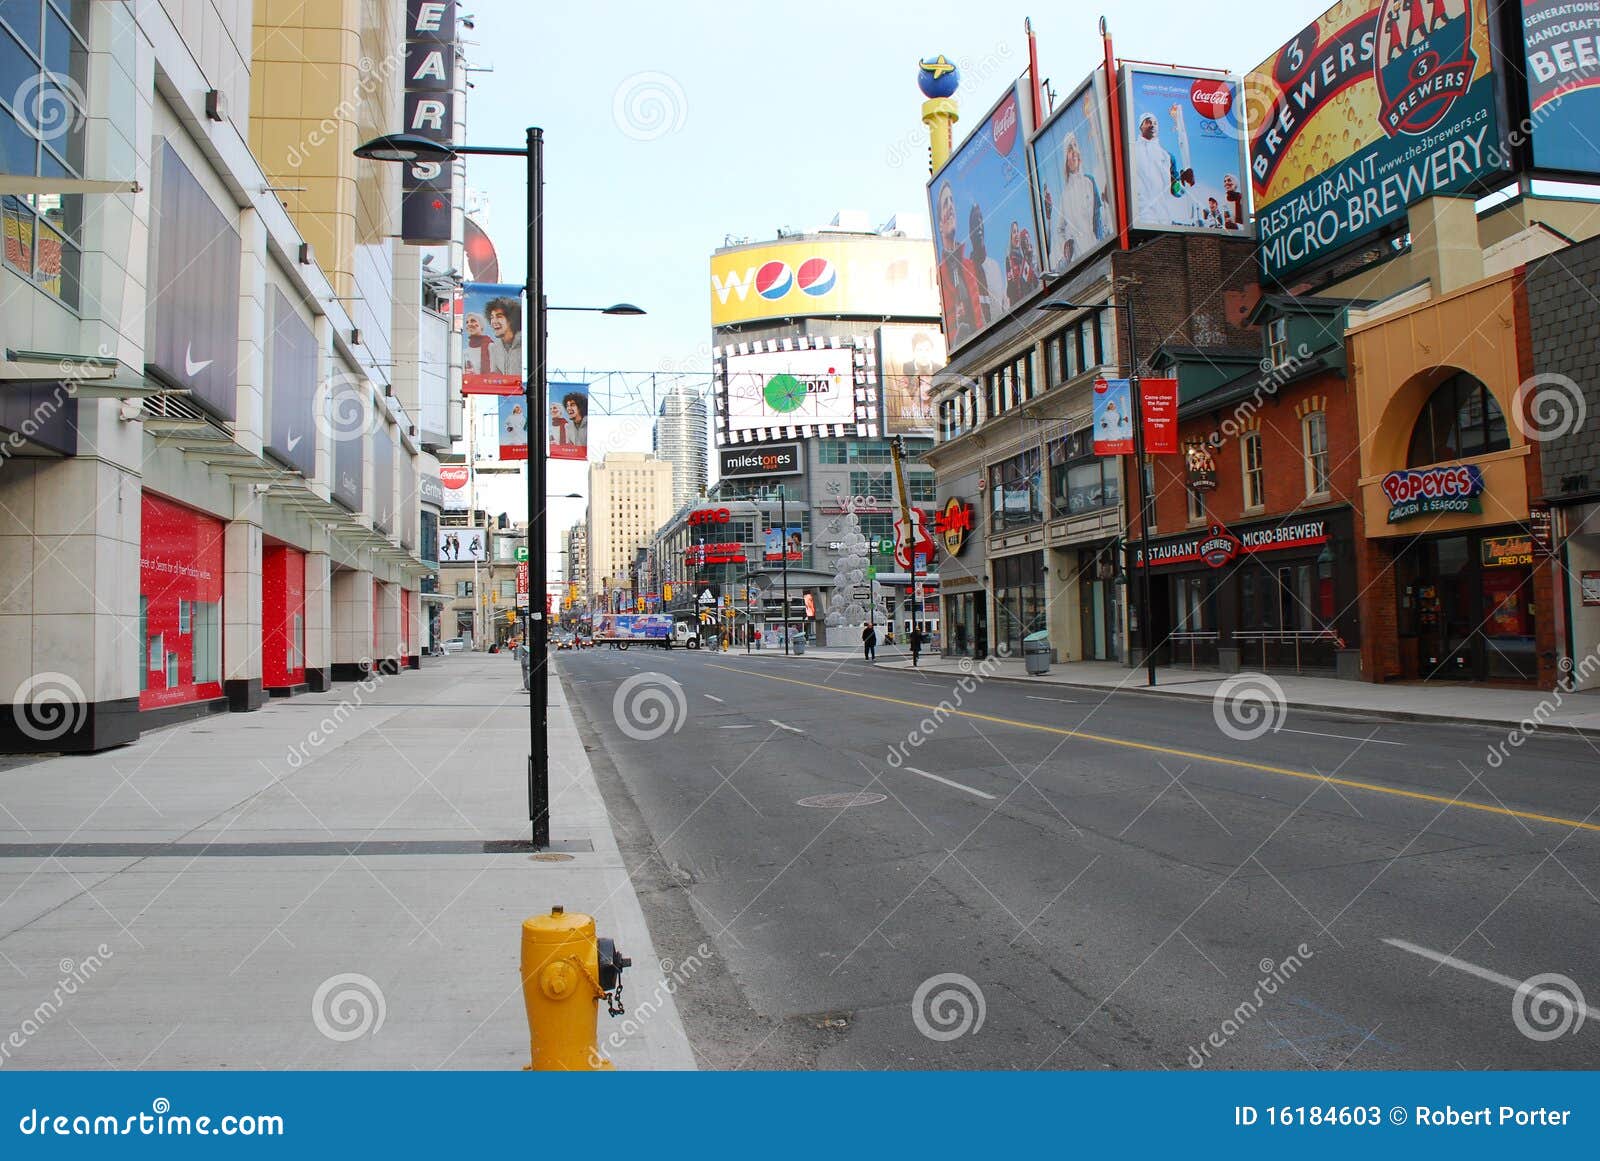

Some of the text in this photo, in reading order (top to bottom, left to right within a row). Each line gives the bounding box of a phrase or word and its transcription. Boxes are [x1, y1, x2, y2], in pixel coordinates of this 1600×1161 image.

[1287, 38, 1303, 72] 3
[1413, 41, 1430, 56] THE
[1528, 36, 1600, 83] BEE
[1418, 58, 1428, 76] 3
[1252, 31, 1374, 179] BREWERS
[1389, 71, 1465, 126] BREWERS
[1378, 108, 1487, 175] www.the3brewers.ca
[1260, 151, 1379, 241] RESTAURANT
[1261, 124, 1488, 276] MICRO-BREWERY
[727, 453, 791, 469] milestones
[1389, 500, 1469, 520] CHICKEN & SEAFOOD
[1213, 526, 1218, 535] 3
[1242, 521, 1324, 547] MICRO-BREWERY
[1137, 541, 1199, 562] RSTAURANT
[1201, 538, 1232, 556] BREWERS
